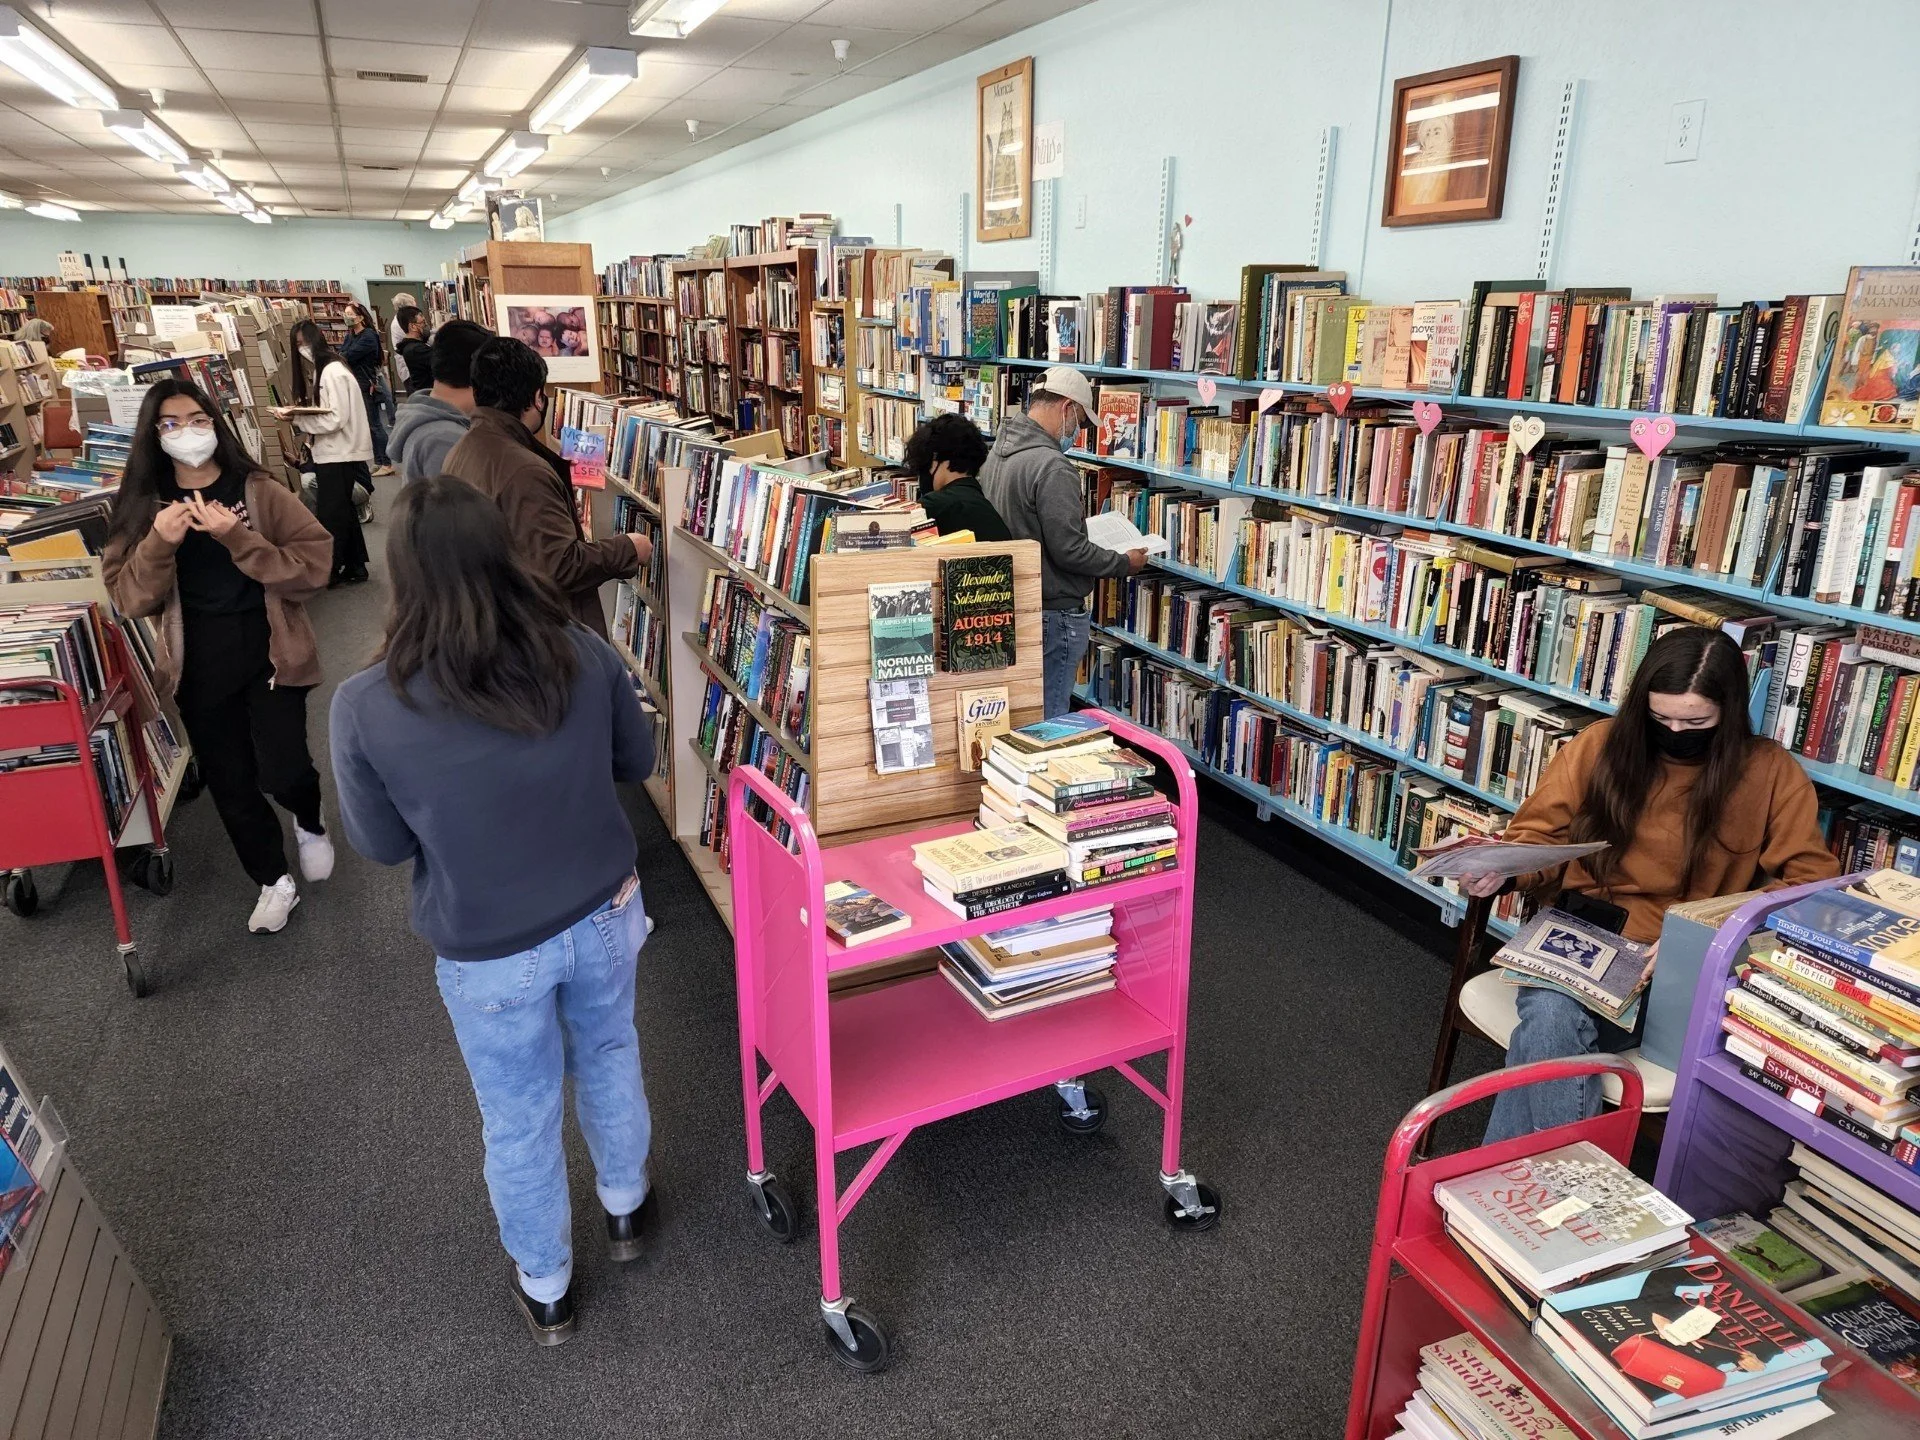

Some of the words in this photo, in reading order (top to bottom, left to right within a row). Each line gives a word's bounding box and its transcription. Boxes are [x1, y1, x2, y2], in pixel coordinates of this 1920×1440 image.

[384, 265, 402, 276] EXIT
[973, 290, 995, 299] World's
[1241, 307, 1245, 316] OF
[1550, 310, 1560, 324] LEE
[1649, 305, 1659, 333] JEFFREY
[1780, 304, 1799, 335] PENNY
[1238, 319, 1246, 361] UNIVERSITY
[1546, 326, 1558, 349] CHILD
[1646, 336, 1656, 364] ARCHER
[1769, 335, 1793, 386] DREADFULS
[564, 428, 604, 444] VICTIM
[570, 466, 605, 476] LSEN
[765, 474, 812, 488] LANDFALL
[1815, 468, 1823, 486] Search
[1658, 486, 1668, 508] HENRY
[1807, 495, 1816, 520] America
[1895, 492, 1908, 520] Breathing
[1653, 509, 1663, 532] JAMES
[1893, 522, 1901, 531] the
[1890, 533, 1899, 545] Fire
[958, 572, 1007, 587] Alexander
[1388, 549, 1398, 601] PARNASSUS
[954, 590, 1011, 606] Solzhenitsyn
[953, 613, 1013, 630] AUGUST
[965, 632, 1003, 647] 1914
[1861, 638, 1910, 656] EMERSON
[1862, 632, 1912, 648] WALDO
[878, 655, 933, 668] NORMAN
[1775, 638, 1789, 666] DAVID
[1789, 643, 1808, 678] Dish
[1807, 643, 1822, 674] CHARLES
[878, 664, 934, 679] MAILER
[1766, 669, 1783, 716] BRINKLEY
[1802, 675, 1816, 704] KURALT
[1903, 678, 1915, 698] TOM
[965, 700, 1006, 723] Garp
[1871, 698, 1887, 729] TROUBLE
[1896, 698, 1910, 725] WOLFE
[1889, 727, 1902, 756] HOOKING
[1074, 797, 1105, 808] Codependent
[1390, 797, 1401, 834] FORENSICS
[1087, 825, 1118, 837] DEMOCRACY
[971, 886, 994, 898] DESIRE
[994, 885, 1001, 893] IN
[1002, 878, 1036, 892] LANGUAGE
[969, 904, 983, 912] THE
[984, 895, 1014, 907] IDEOLOGY
[1015, 892, 1024, 900] OF
[973, 910, 986, 918] THE
[988, 902, 1022, 914] AESTHETIC
[1777, 918, 1809, 937] finding
[1810, 932, 1832, 947] your
[1835, 941, 1859, 956] voice
[1855, 919, 1916, 949] voice
[1794, 962, 1811, 976] SYD
[1810, 970, 1834, 987] FIELD
[1816, 950, 1833, 962] THE
[1833, 958, 1867, 978] WRITER'S
[1869, 974, 1912, 998] CHAPBOOK
[1742, 980, 1771, 1001] Elizabeth
[1771, 997, 1799, 1017] George
[1817, 1021, 1837, 1036] Write
[1836, 1032, 1860, 1050] Away
[1810, 1010, 1838, 1031] Application
[1842, 1009, 1875, 1031] TALES
[1739, 1003, 1754, 1015] How
[1754, 1011, 1762, 1019] to
[1797, 1035, 1813, 1047] Your
[1813, 1043, 1832, 1057] First
[1832, 1054, 1851, 1068] Novel
[1747, 1068, 1759, 1079] SAY
[1760, 1076, 1783, 1093] WHAT?
[1765, 1060, 1822, 1100] Stylebook
[1492, 1189, 1559, 1241] STEEL
[1501, 1162, 1606, 1247] DANLLE
[1467, 1190, 1494, 1212] Past
[1493, 1214, 1541, 1252] Perfect
[1594, 1308, 1625, 1331] from
[1612, 1305, 1646, 1327] Fall
[1682, 1292, 1763, 1349] STEEL
[1684, 1262, 1814, 1357] DANIELLE
[1822, 1316, 1834, 1327] A
[1832, 1302, 1901, 1328] QUILTER'S
[1582, 1310, 1619, 1344] Grace
[1842, 1314, 1920, 1348] CHRISTMAS
[1431, 1344, 1490, 1398] Homes
[1719, 1421, 1742, 1436] USE
[1744, 1412, 1765, 1429] NOT
